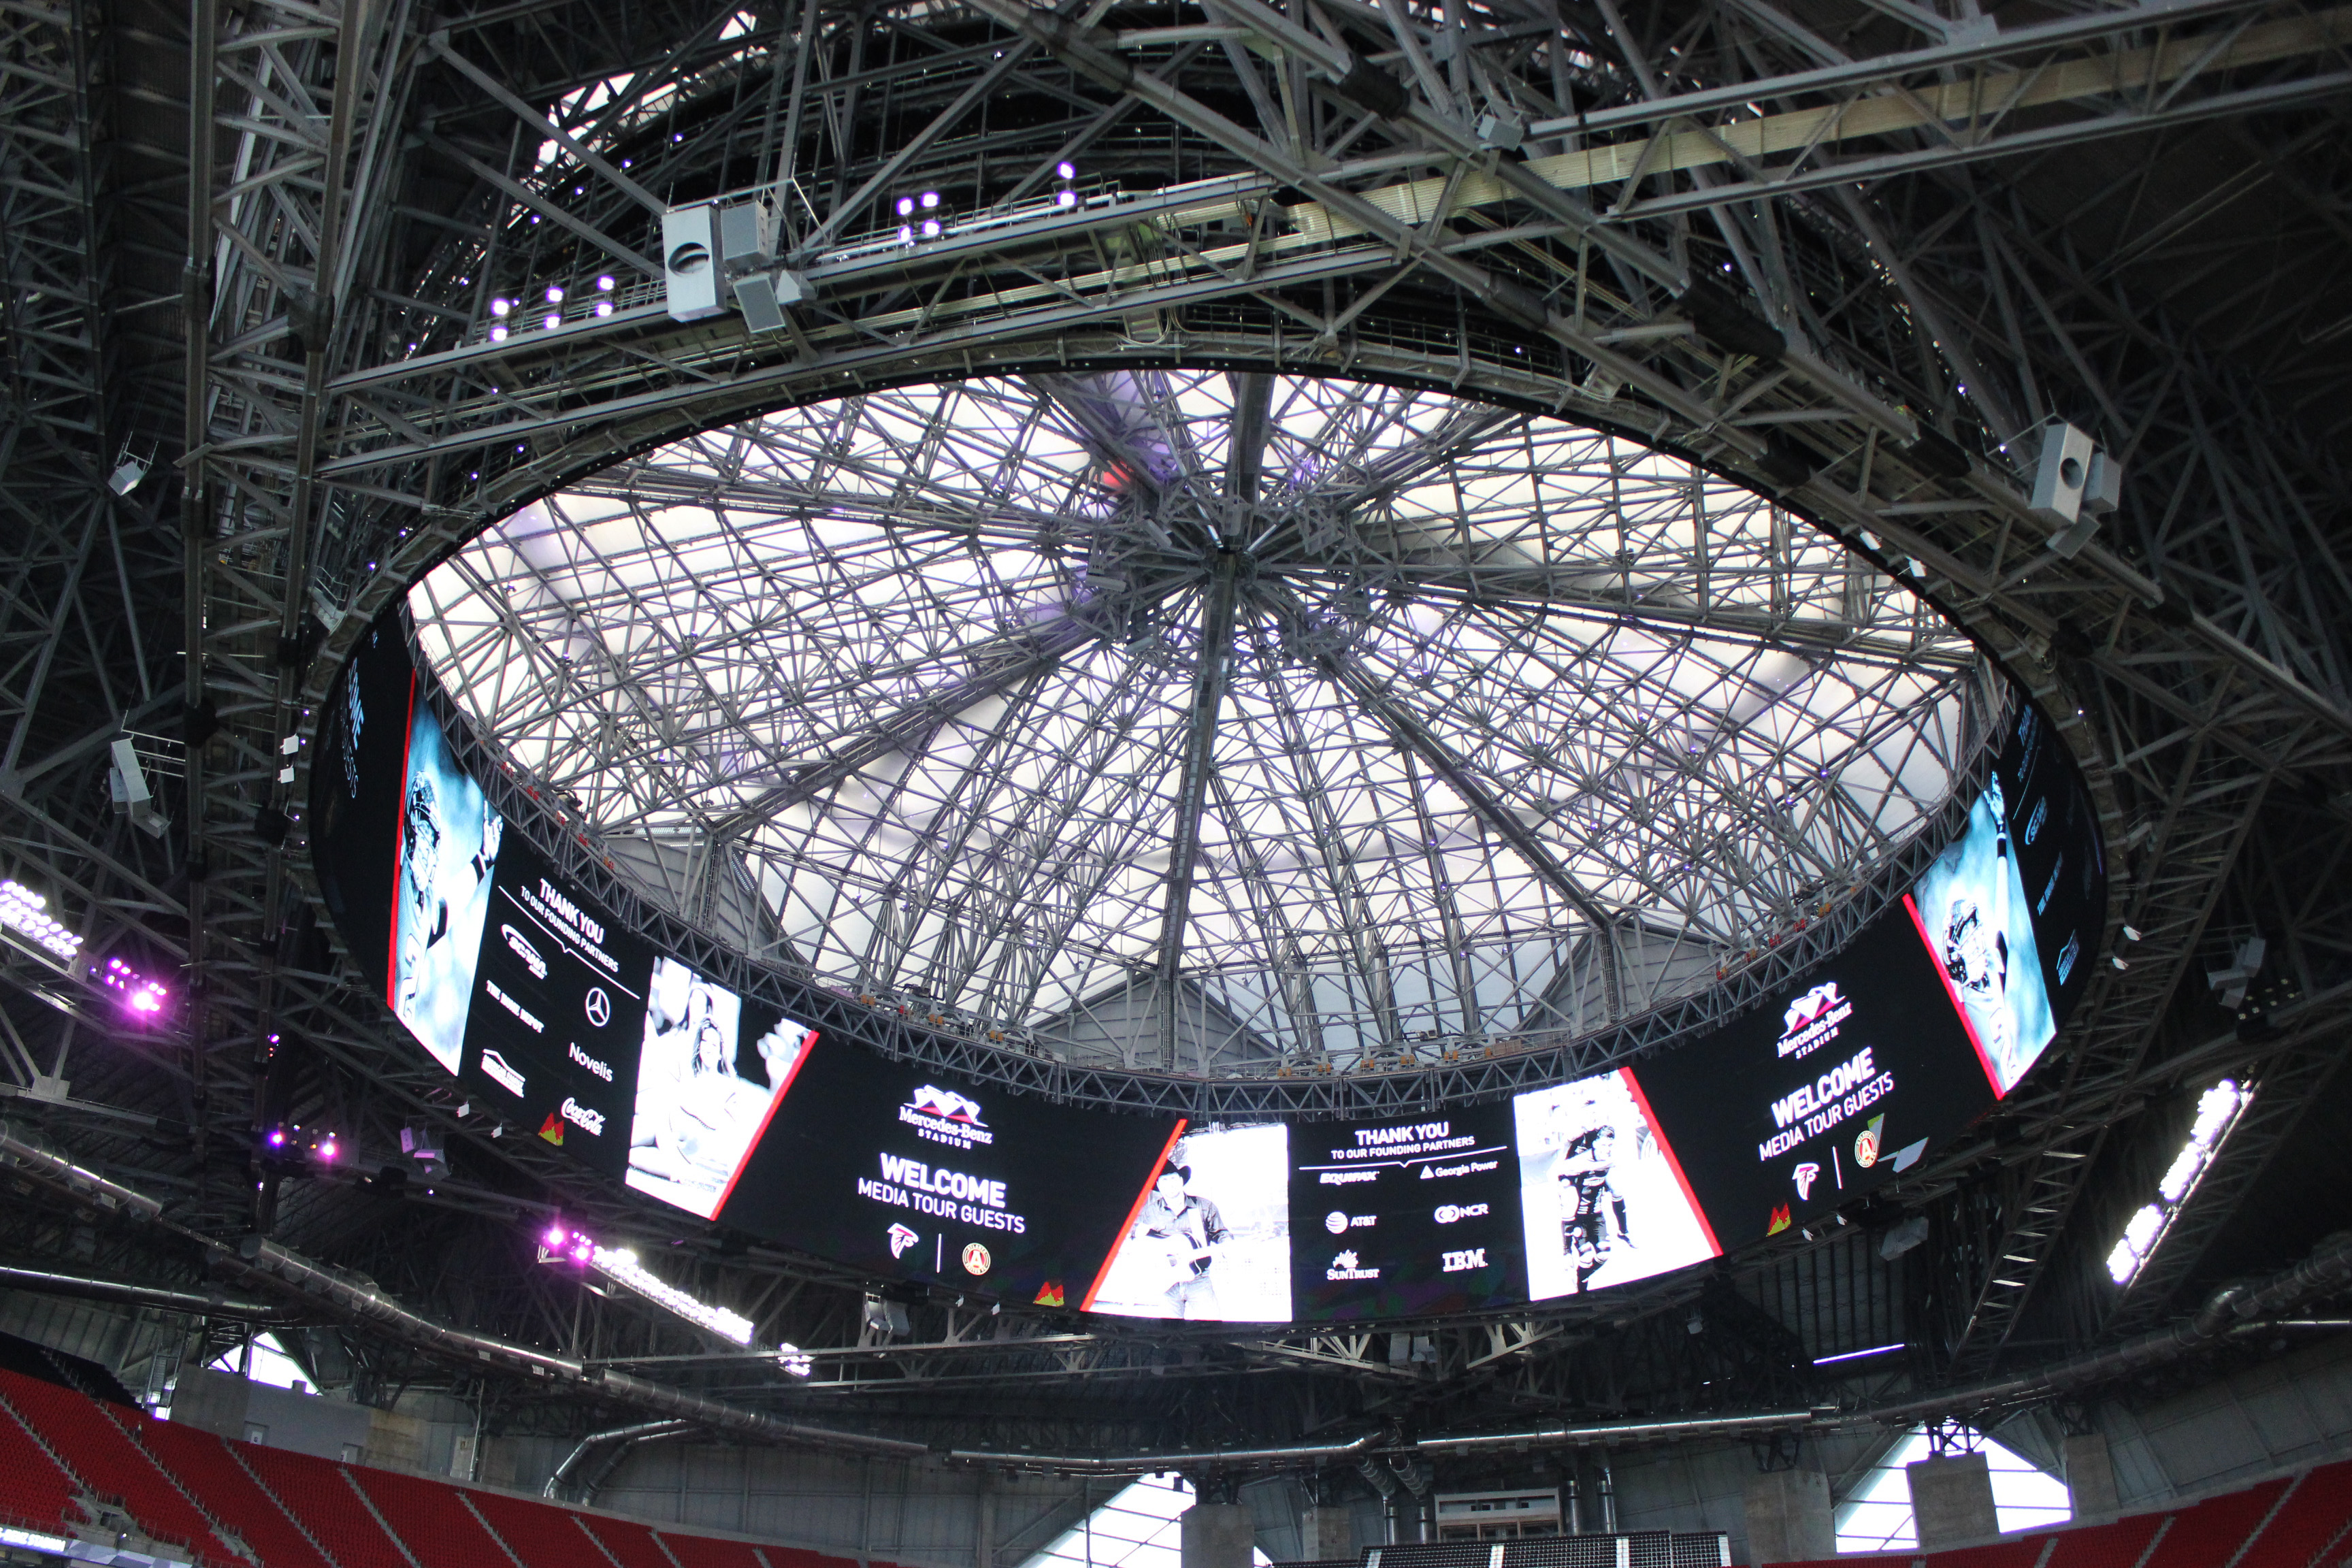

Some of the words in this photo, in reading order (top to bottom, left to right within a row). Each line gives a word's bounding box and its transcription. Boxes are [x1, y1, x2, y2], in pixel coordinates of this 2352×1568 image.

[521, 885, 530, 901] TO
[530, 896, 544, 915] OUR
[544, 908, 581, 945] FOUNDING
[581, 937, 619, 973] PARTNERS
[540, 878, 579, 927] THANK
[580, 913, 604, 944] YOU
[1776, 1002, 1852, 1058] Mercedes-Benz
[1795, 1026, 1839, 1059] STADIUM
[569, 1042, 613, 1082] Novelis
[1771, 1046, 1876, 1128] WELCOME
[898, 1106, 992, 1145] Mercedes-Benz
[1354, 1126, 1414, 1146] THANK
[1415, 1122, 1450, 1140] YOU
[1759, 1126, 1806, 1162] MEDIA
[1804, 1103, 1843, 1138] TOUR
[1843, 1071, 1895, 1117] GUESTS
[918, 1128, 972, 1149] STADIUM
[1331, 1149, 1345, 1160] TO
[1346, 1149, 1368, 1159] OUR
[1369, 1143, 1421, 1158] FOUNDING
[1423, 1136, 1475, 1152] PARTNERS
[880, 1152, 1007, 1209] WELCOME
[1435, 1164, 1470, 1177] Georgia
[1471, 1160, 1499, 1173] Power
[858, 1177, 909, 1208] MEDIA
[912, 1192, 958, 1220] TOUR
[960, 1205, 1026, 1234] GUESTS
[1350, 1215, 1377, 1227] AT&T
[1460, 1203, 1489, 1218] NCR
[1442, 1248, 1485, 1273] IBM
